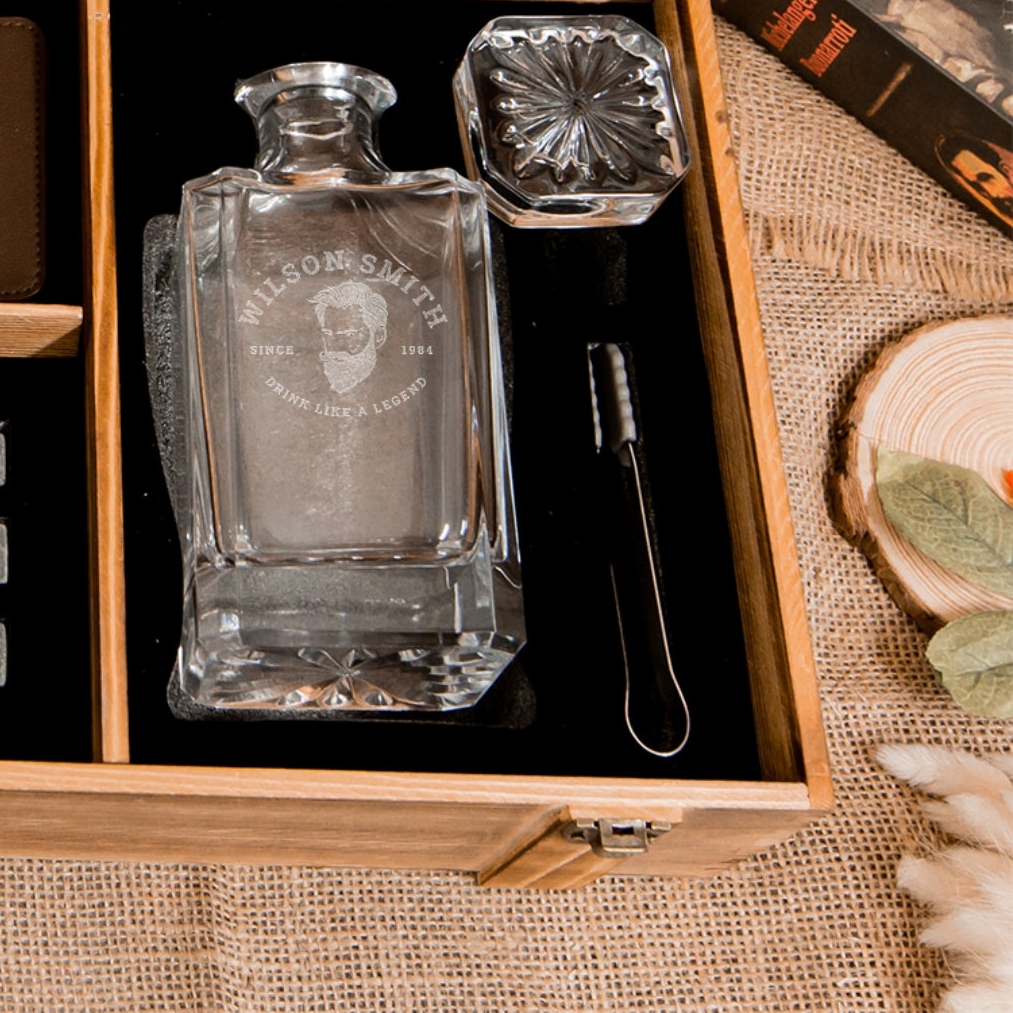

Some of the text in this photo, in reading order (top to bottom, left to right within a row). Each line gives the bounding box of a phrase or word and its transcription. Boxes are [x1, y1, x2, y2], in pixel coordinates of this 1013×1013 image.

[238, 250, 448, 329] WILSON SMITH
[249, 345, 434, 356] SINCE 1984
[264, 376, 427, 418] DRINK LIKE A LEGEND
